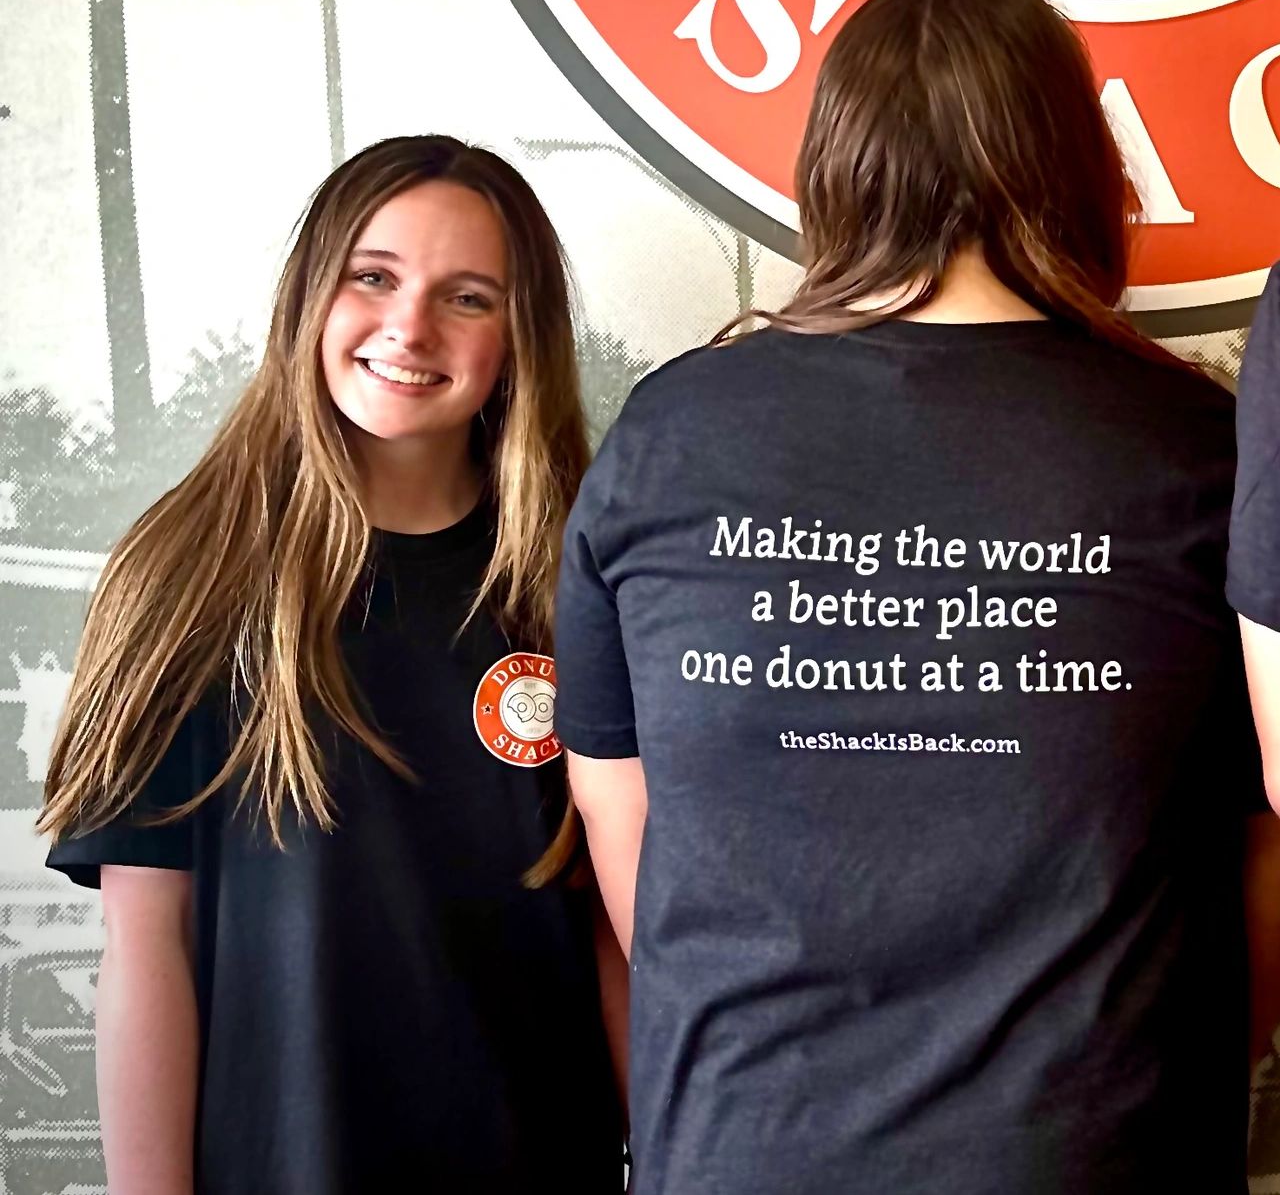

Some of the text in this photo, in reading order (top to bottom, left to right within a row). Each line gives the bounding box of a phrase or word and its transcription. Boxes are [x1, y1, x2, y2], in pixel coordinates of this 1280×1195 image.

[709, 516, 1112, 576] Making the world
[751, 579, 1058, 640] a better place
[491, 659, 554, 686] DONU
[681, 644, 1132, 693] one donut at a time.
[779, 730, 1021, 754] theShackIsBack.com
